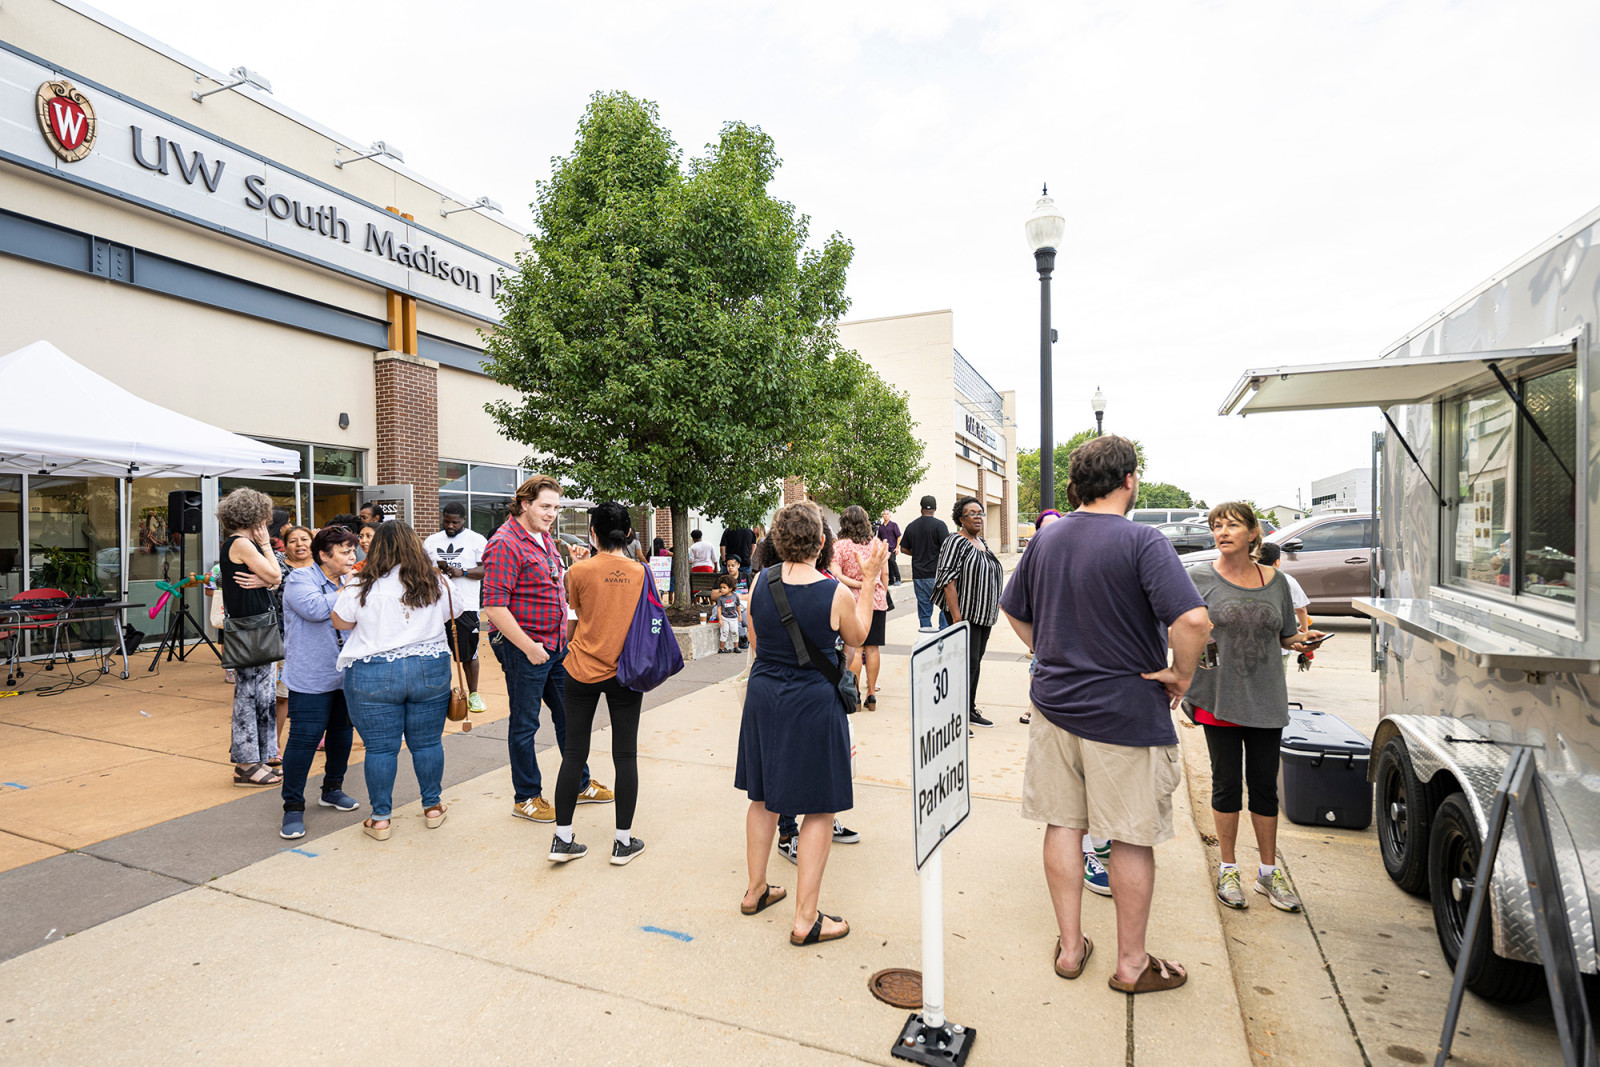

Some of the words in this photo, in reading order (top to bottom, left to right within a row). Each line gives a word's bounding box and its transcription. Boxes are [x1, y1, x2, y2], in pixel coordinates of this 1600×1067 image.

[53, 102, 85, 145] W
[130, 125, 226, 193] UW
[244, 174, 351, 244] South
[364, 222, 481, 293] Madison
[933, 667, 949, 705] 30
[920, 713, 962, 769] Minute
[919, 759, 964, 825] Parking
